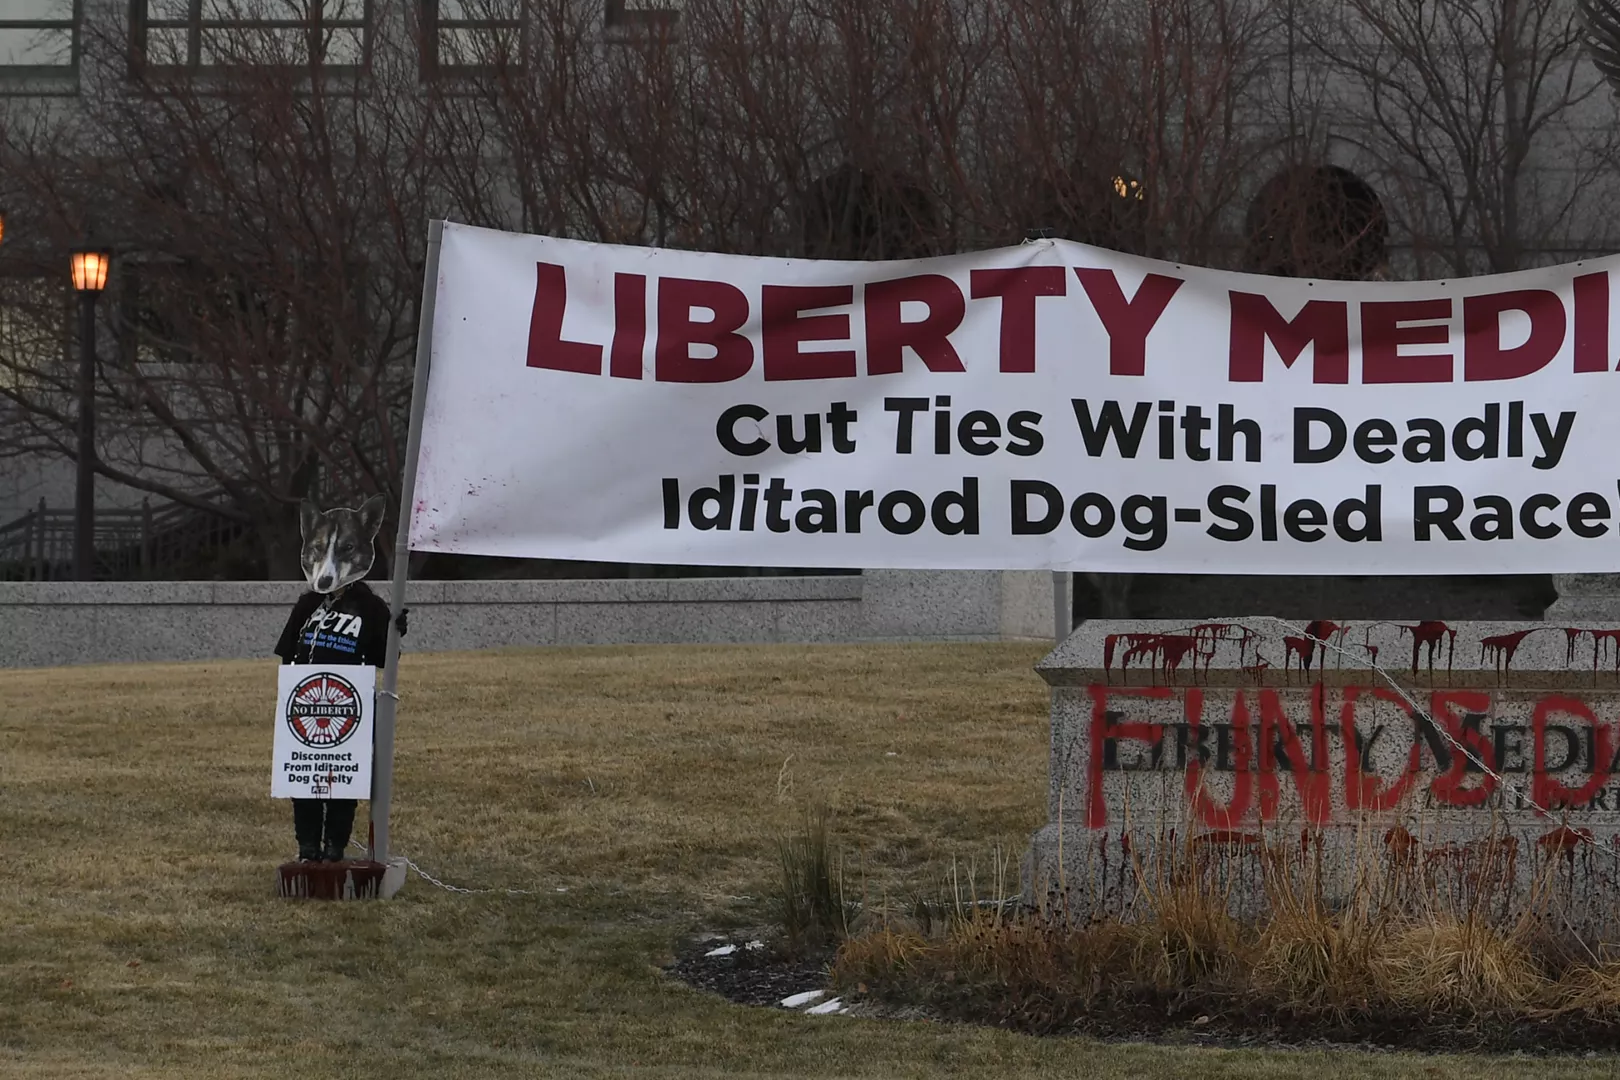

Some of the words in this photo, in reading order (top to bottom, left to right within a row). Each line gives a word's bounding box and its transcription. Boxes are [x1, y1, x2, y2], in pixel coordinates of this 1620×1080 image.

[526, 261, 1184, 383] LIBERTY
[716, 401, 857, 457] Cut
[884, 395, 1044, 457] Ties
[1071, 398, 1262, 462] With
[1292, 400, 1577, 471] Deadly
[662, 474, 980, 536] Iditarod
[1010, 479, 1382, 552] Dog-Sled
[292, 705, 308, 716] NO
[310, 705, 356, 716] LIBERTY
[284, 763, 312, 772] From
[314, 763, 359, 772] Iditarod
[291, 751, 352, 761] Disconnect
[1085, 683, 1498, 829] FUNDS
[288, 774, 310, 784] Dog
[312, 774, 353, 785] Cruelty
